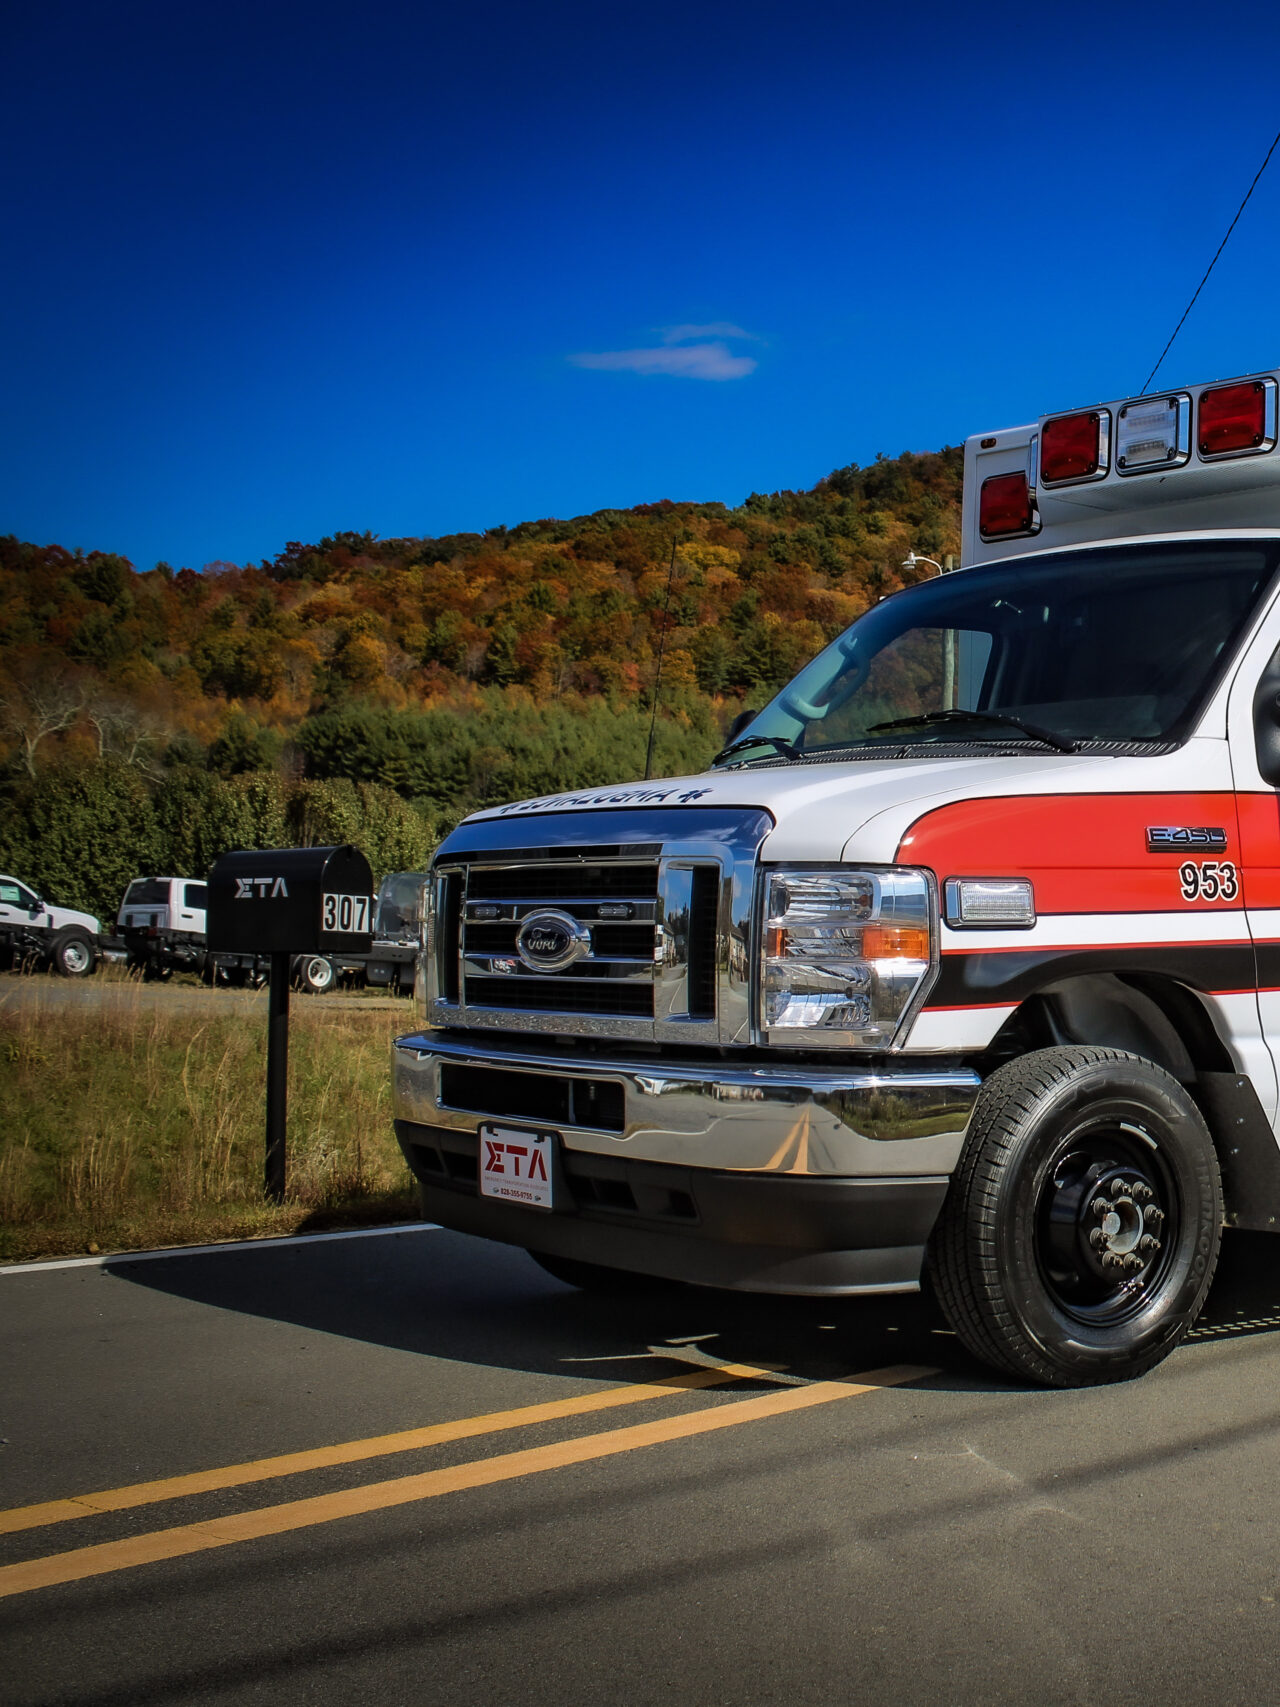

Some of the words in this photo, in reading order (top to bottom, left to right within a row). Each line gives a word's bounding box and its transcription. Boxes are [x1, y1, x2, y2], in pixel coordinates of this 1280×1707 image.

[1178, 861, 1239, 901] 953
[324, 895, 367, 931] 307
[528, 927, 558, 951] Ford
